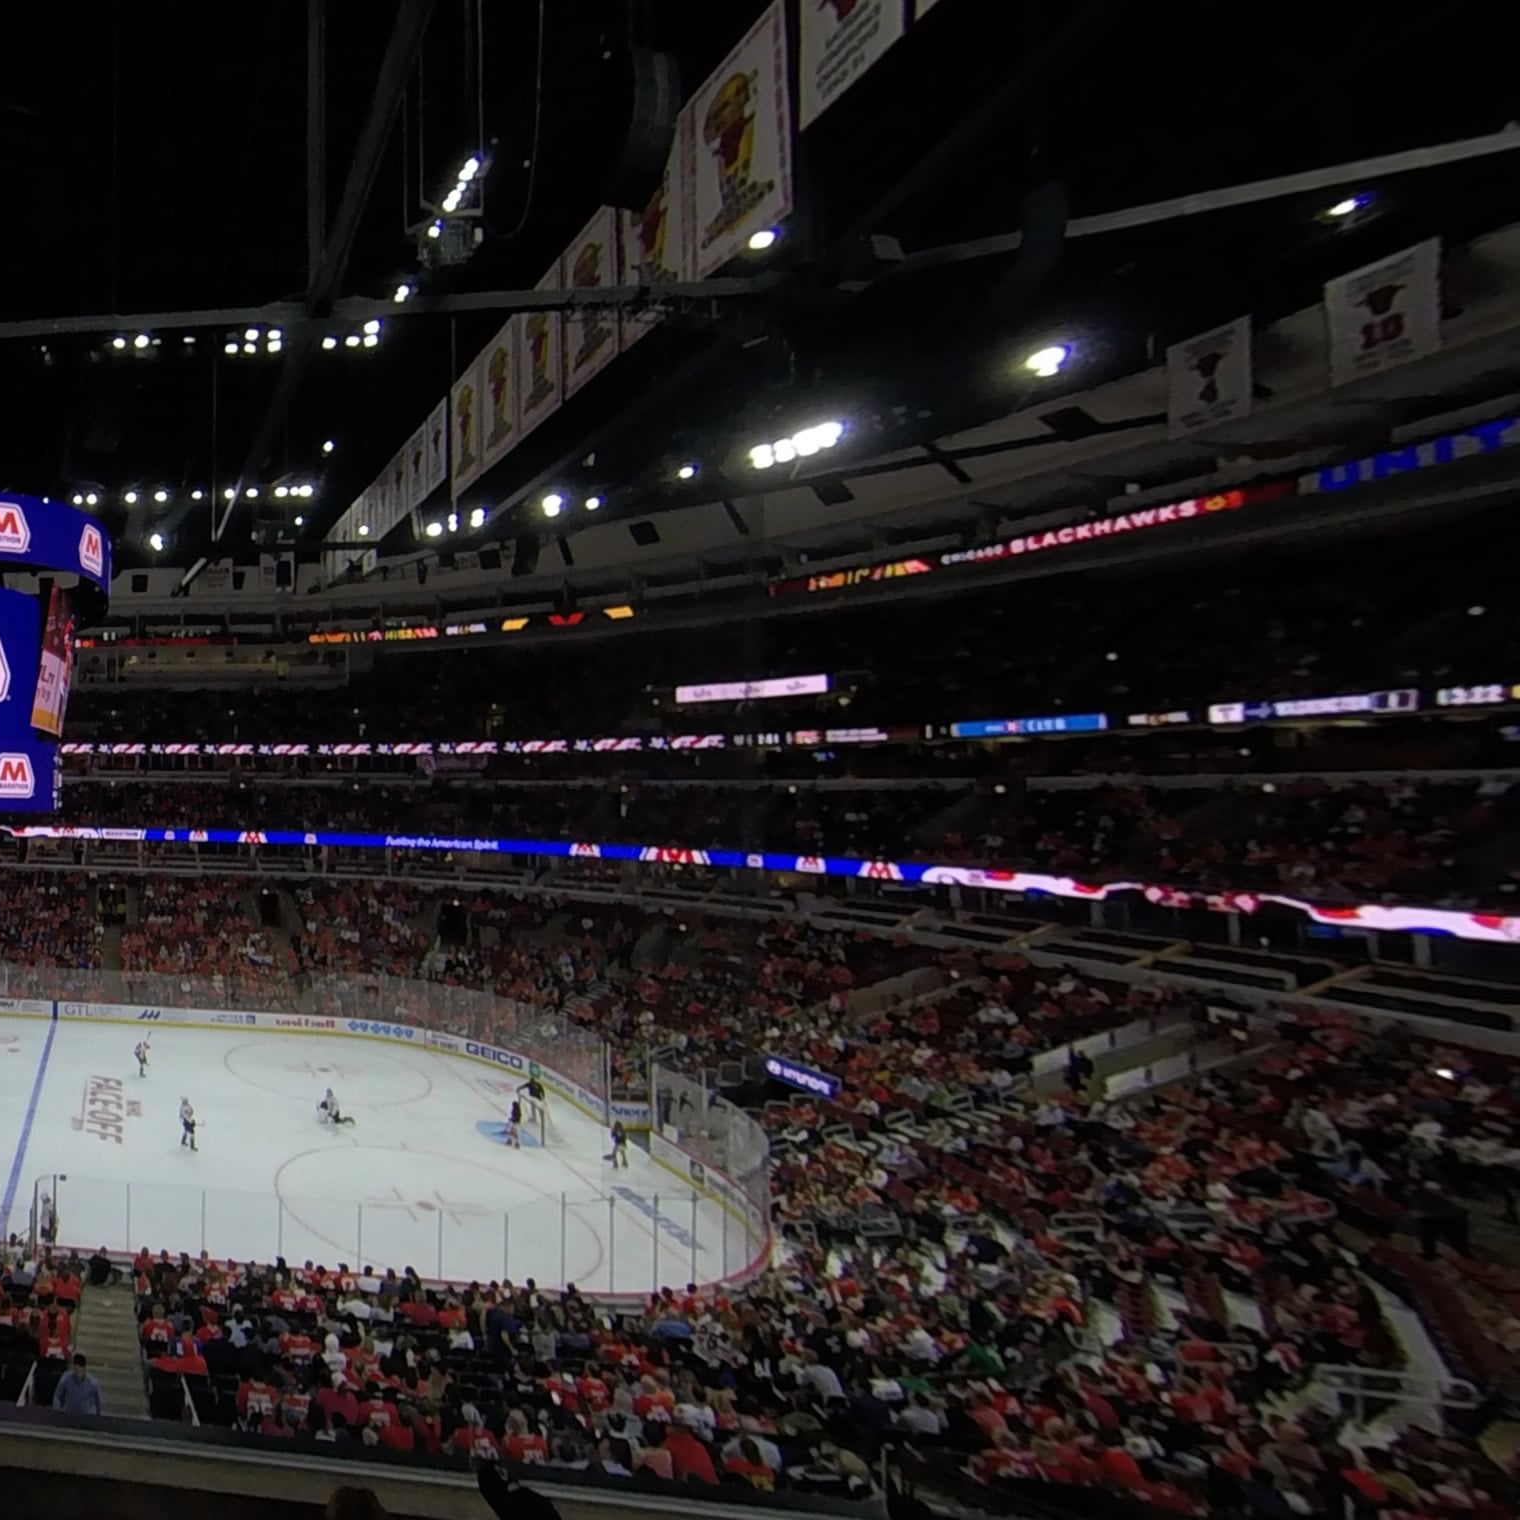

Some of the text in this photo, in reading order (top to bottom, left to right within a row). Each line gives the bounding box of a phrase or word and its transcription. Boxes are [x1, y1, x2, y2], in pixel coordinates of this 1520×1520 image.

[1010, 499, 1198, 554] BLACKHAWKS
[0, 761, 28, 782] M
[465, 1041, 523, 1070] GEICO
[85, 1075, 123, 1144] FACE-OFF
